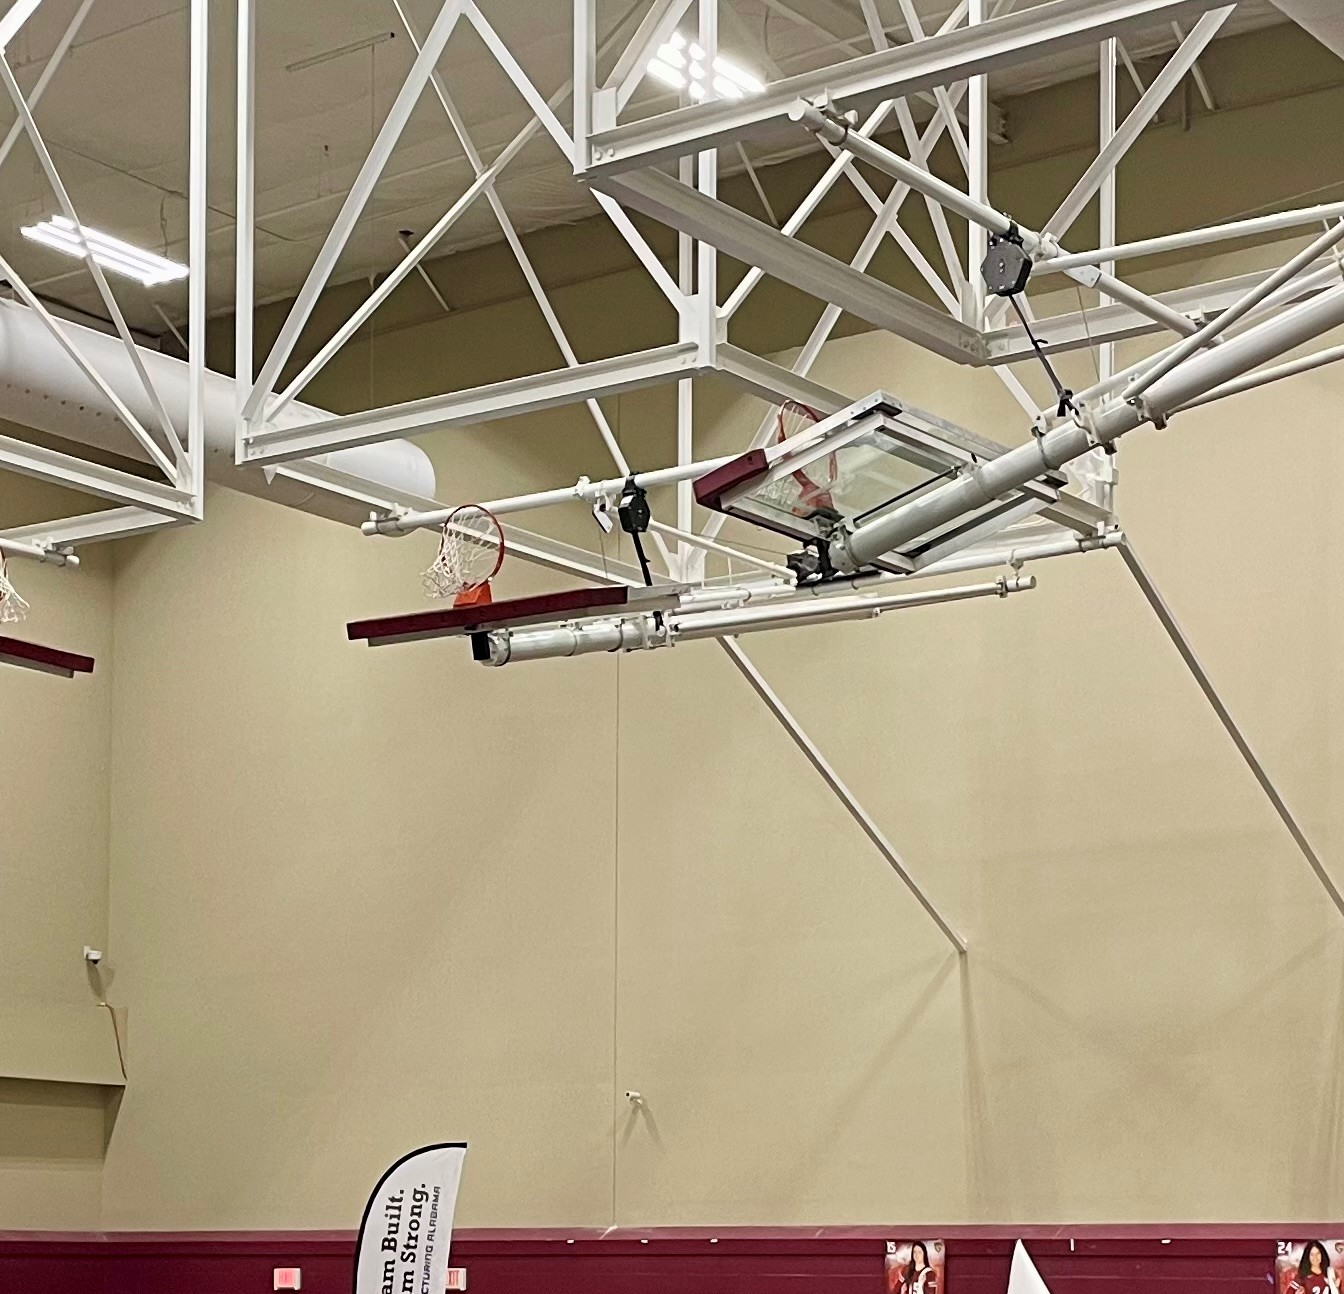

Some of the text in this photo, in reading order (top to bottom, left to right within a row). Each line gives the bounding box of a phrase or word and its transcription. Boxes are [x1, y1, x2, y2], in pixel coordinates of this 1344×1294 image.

[381, 1189, 404, 1252] Built.
[401, 1183, 429, 1263] Strong.
[427, 1186, 441, 1242] ALABAMA
[1277, 1241, 1292, 1254] 24
